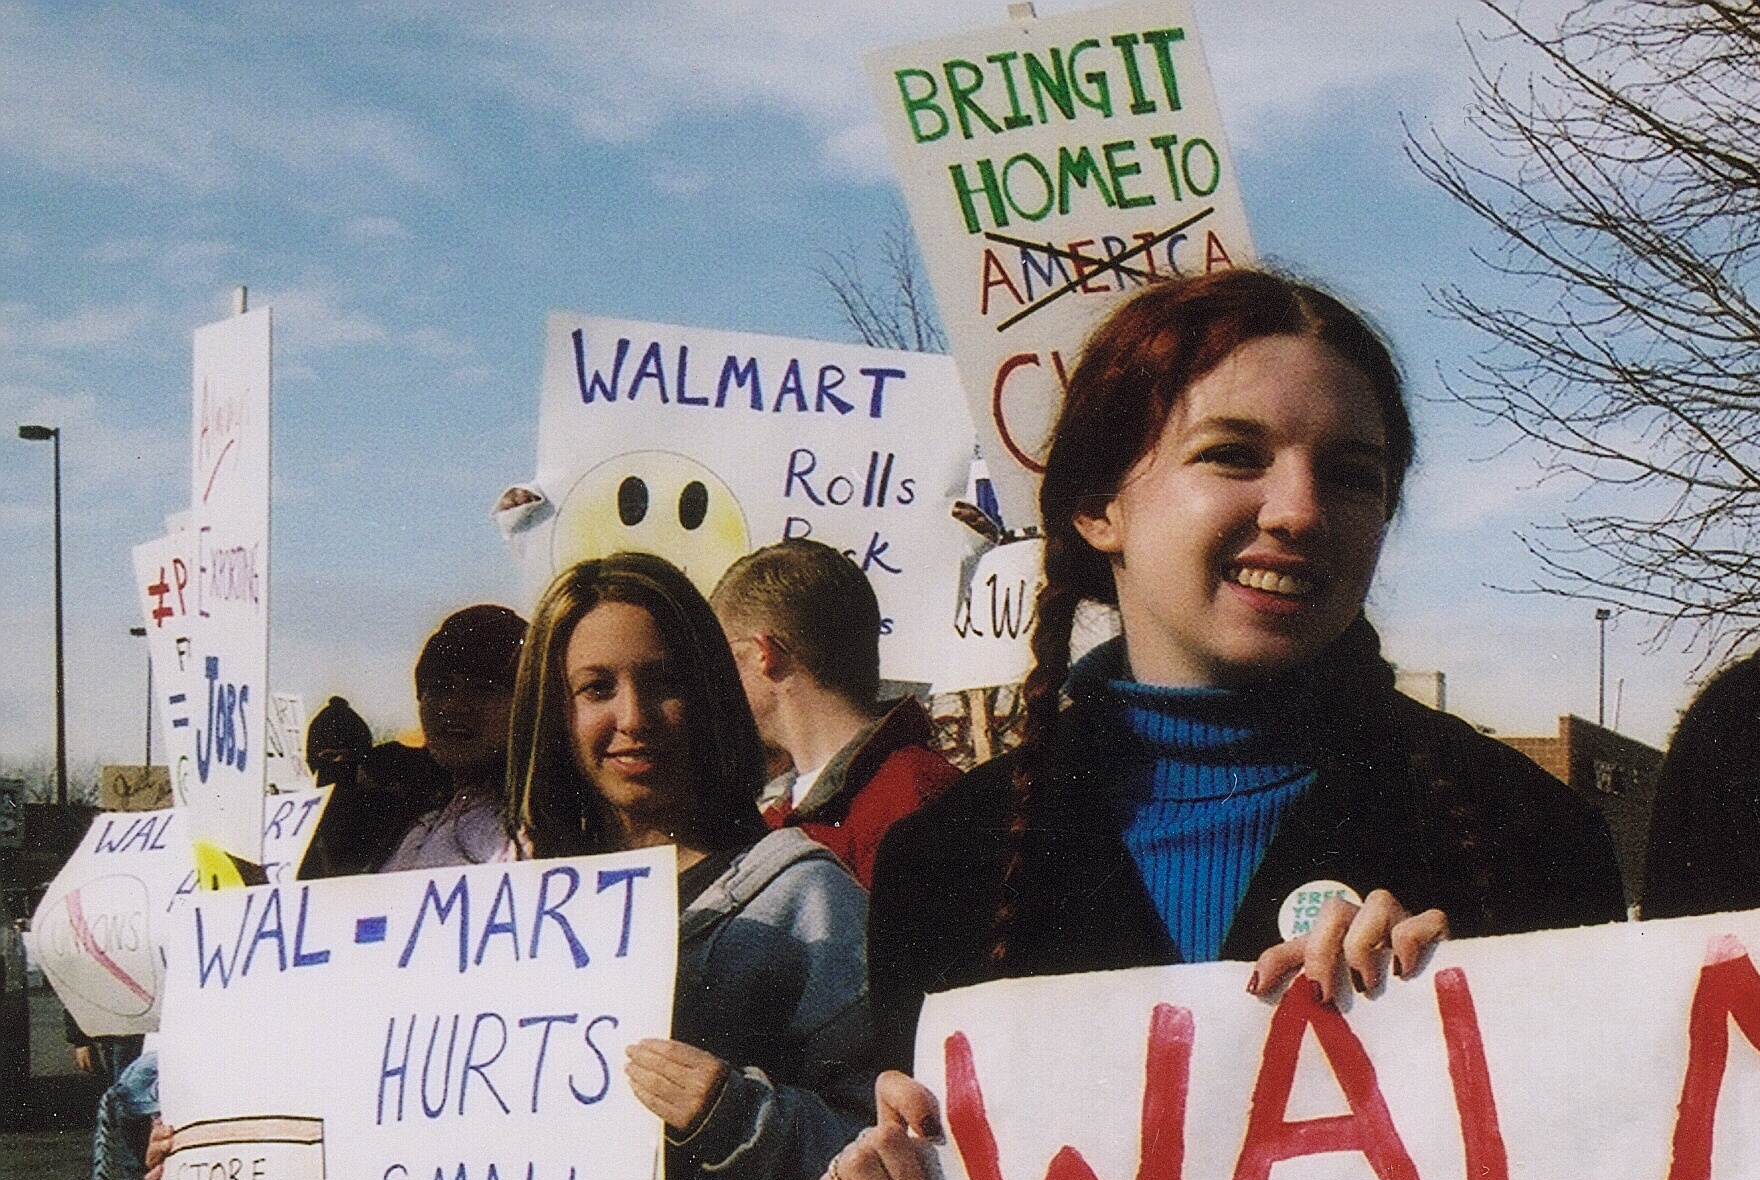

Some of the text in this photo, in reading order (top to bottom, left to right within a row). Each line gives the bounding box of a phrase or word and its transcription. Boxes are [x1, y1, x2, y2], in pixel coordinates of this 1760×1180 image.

[893, 27, 1186, 144] BRING IT
[948, 134, 1221, 234] HOME TO
[980, 229, 1235, 315] AMERICA
[571, 327, 906, 418] WALMART
[784, 448, 917, 509] Rolls
[195, 866, 651, 989] WAL-MART
[376, 1012, 619, 1126] HURTS
